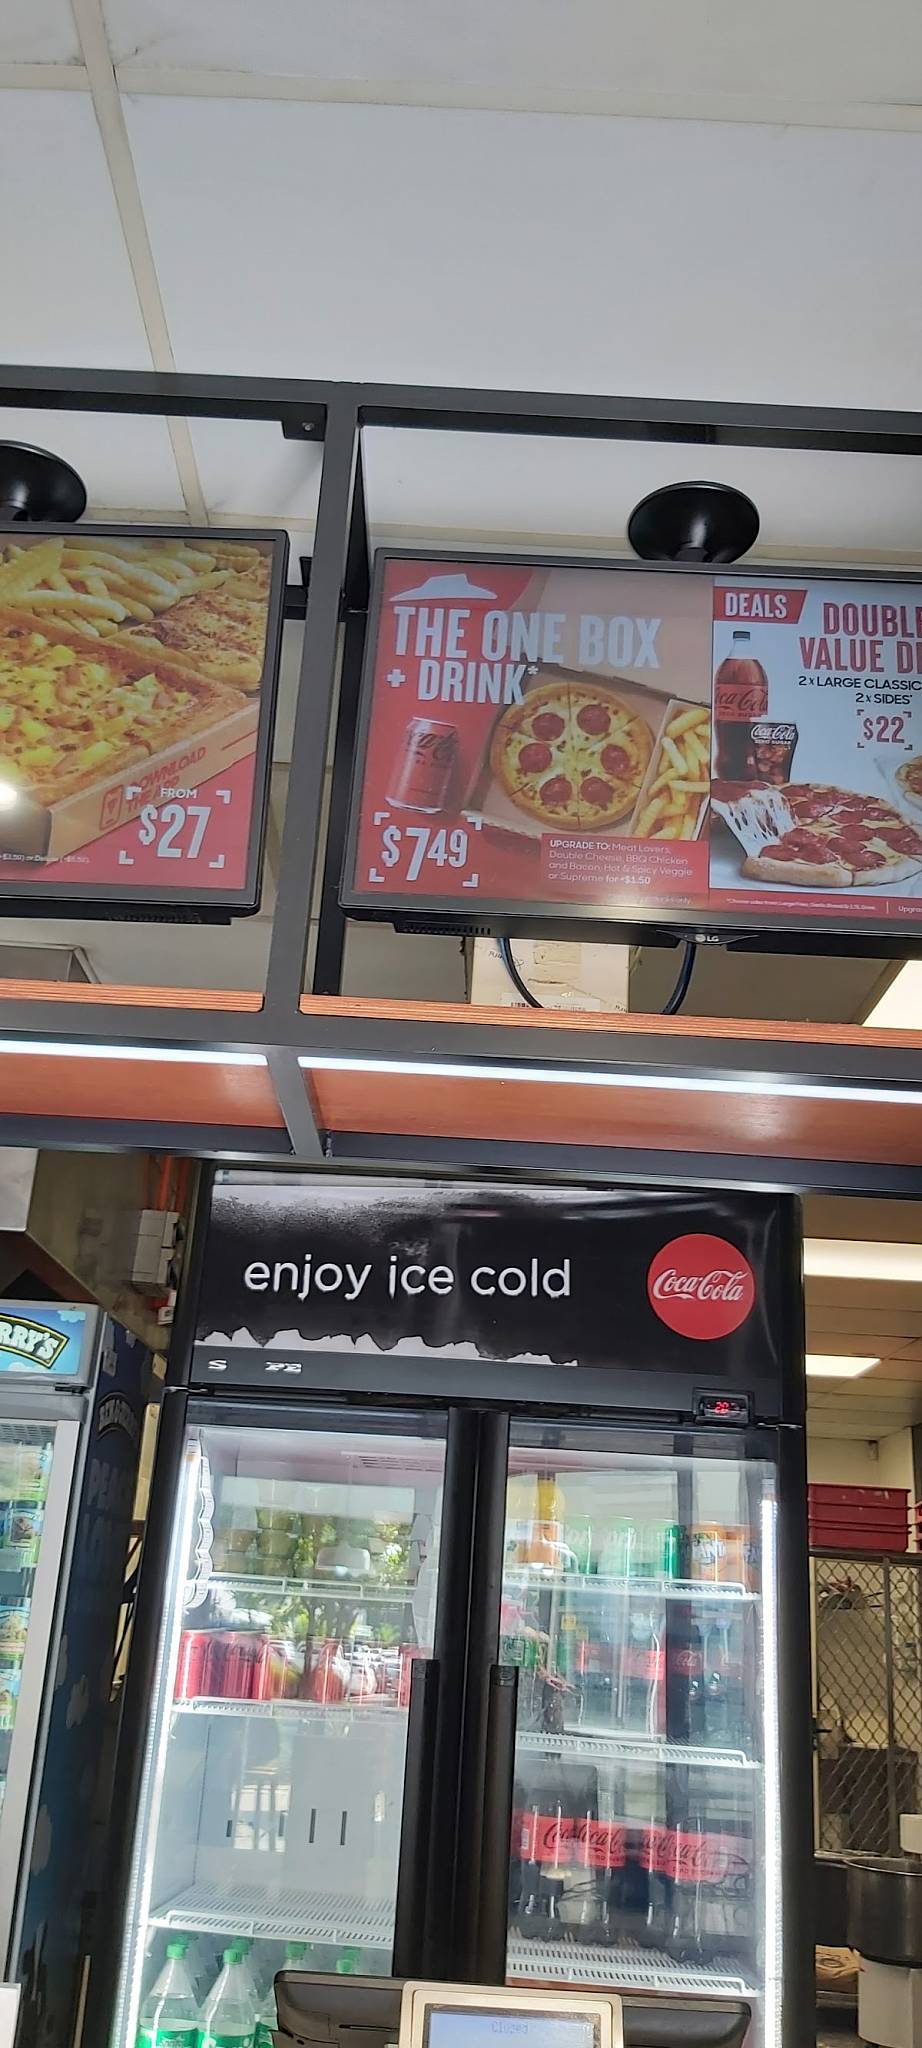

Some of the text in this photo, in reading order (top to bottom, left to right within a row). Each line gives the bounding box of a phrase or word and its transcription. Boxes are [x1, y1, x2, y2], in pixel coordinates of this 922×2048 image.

[725, 592, 787, 619] DEALS
[394, 606, 661, 668] THE ONE BOX
[799, 637, 885, 673] VALUE
[816, 676, 862, 689] LARGE
[863, 678, 922, 691] CLASSIC
[863, 715, 905, 744] $22
[160, 787, 198, 799] FROM
[138, 803, 212, 859] $27
[549, 839, 595, 850] UPGRADE
[596, 841, 612, 850] TO:
[612, 843, 638, 852] Meat
[549, 850, 583, 859] Double
[625, 854, 648, 864] BBQ
[648, 855, 689, 865] Chicken
[548, 862, 568, 870] and
[604, 864, 621, 872] Hot
[631, 864, 657, 877] Spicy
[659, 866, 693, 878] Veggie
[548, 872, 559, 880] or
[560, 871, 604, 883] Supreme
[605, 874, 619, 883] for
[706, 935, 720, 943] LG
[244, 1253, 571, 1301] enjoy ice cold
[652, 1269, 748, 1301] Coca-Cola
